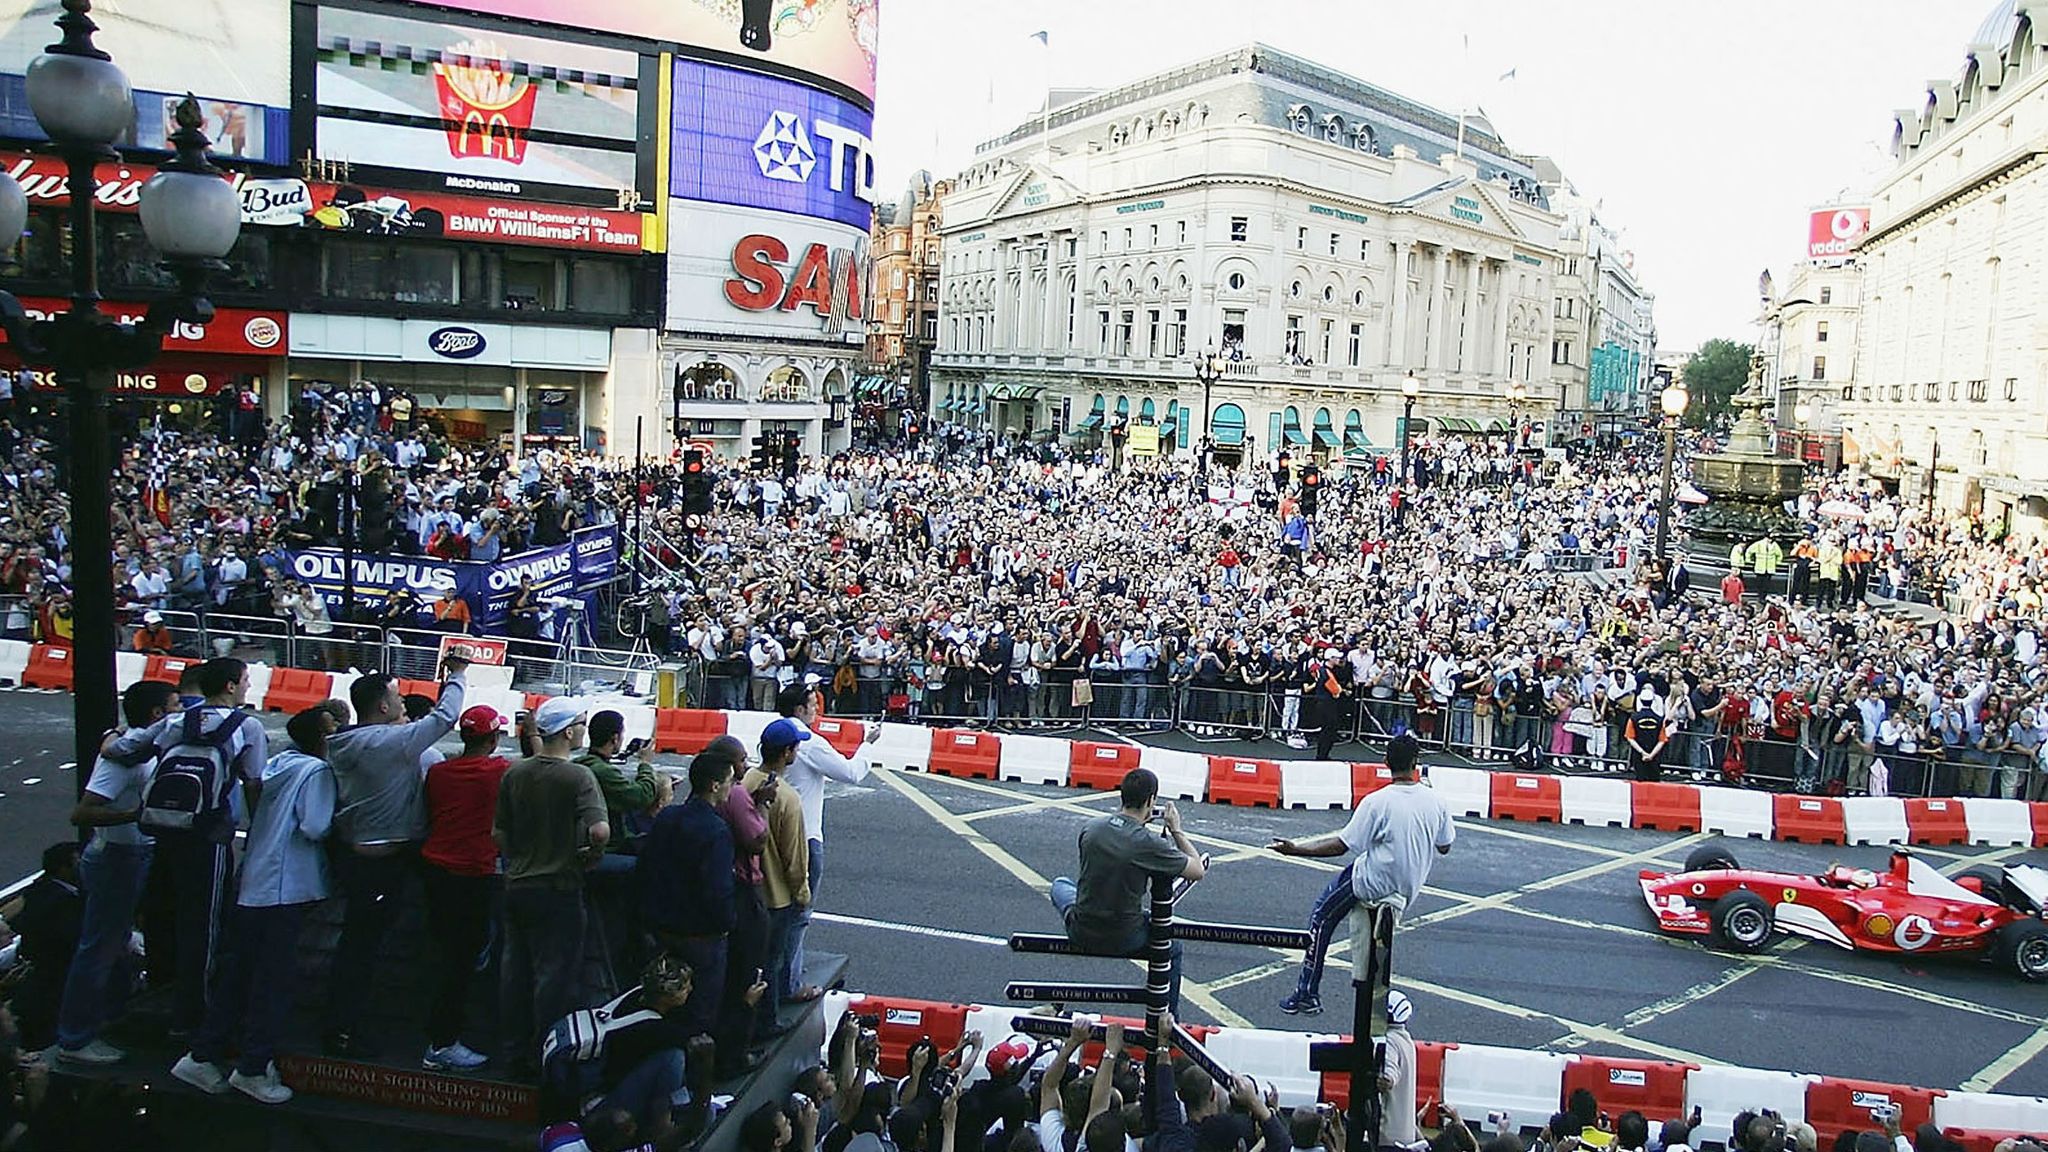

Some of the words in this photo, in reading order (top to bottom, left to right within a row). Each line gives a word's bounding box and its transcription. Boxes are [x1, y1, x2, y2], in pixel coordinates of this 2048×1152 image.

[446, 176, 520, 193] McDonald's
[241, 185, 304, 213] Bud
[450, 215, 497, 234] BMW
[595, 228, 639, 245] Team
[488, 207, 528, 220] Official
[529, 211, 576, 225] Sponsor
[578, 215, 590, 225] of
[591, 216, 609, 227] the
[435, 332, 479, 352] Boots
[294, 555, 457, 590] OLYMPUS
[488, 552, 571, 590] OLYMPUS
[1052, 988, 1091, 999] OXFORD
[306, 1064, 377, 1084] ORIGINAL
[383, 1073, 481, 1098] SIGHTSEEING
